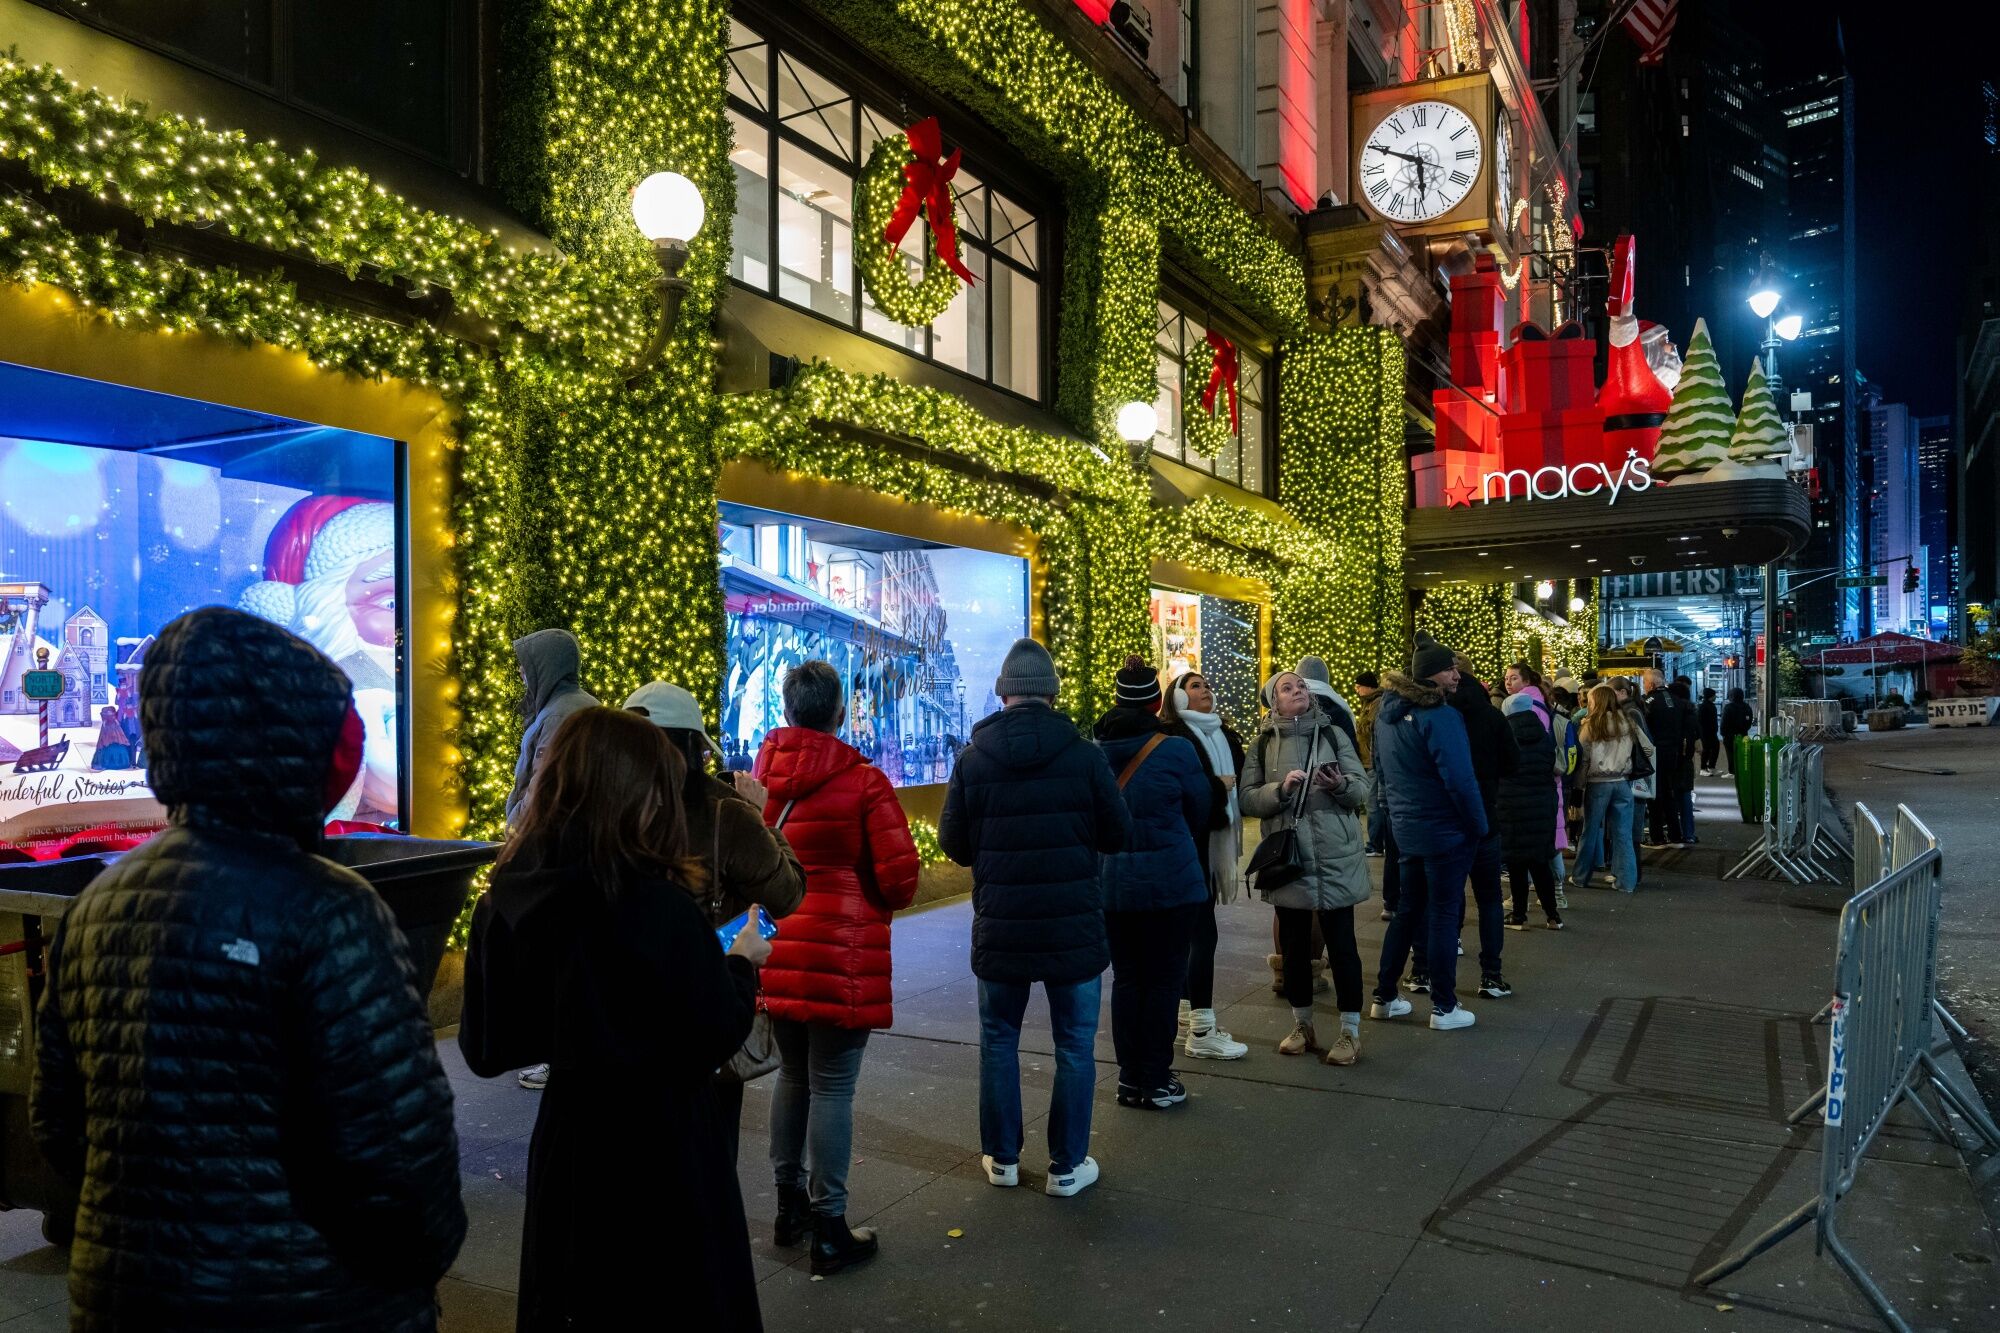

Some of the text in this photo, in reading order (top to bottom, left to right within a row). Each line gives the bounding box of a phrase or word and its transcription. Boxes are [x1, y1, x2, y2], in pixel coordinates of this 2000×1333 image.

[1412, 109, 1427, 129] XII
[1436, 111, 1448, 129] I
[1388, 118, 1406, 139] XI
[1450, 126, 1468, 141] II
[1455, 149, 1475, 160] III
[1366, 163, 1385, 176] IX
[1370, 179, 1391, 202] VIII
[1437, 190, 1452, 207] V
[1388, 193, 1404, 214] VII
[1483, 447, 1651, 505] macy's
[29, 675, 59, 683] NORTH
[1935, 704, 1979, 717] NYPD
[0, 774, 126, 805] onderful Stories
[55, 825, 82, 834] where
[84, 821, 128, 831] Christmas
[128, 819, 154, 828] would
[60, 837, 75, 846] the
[77, 834, 113, 844] moment
[114, 832, 125, 841] he
[126, 831, 150, 840] knew
[1828, 1020, 1845, 1120] NYPD
